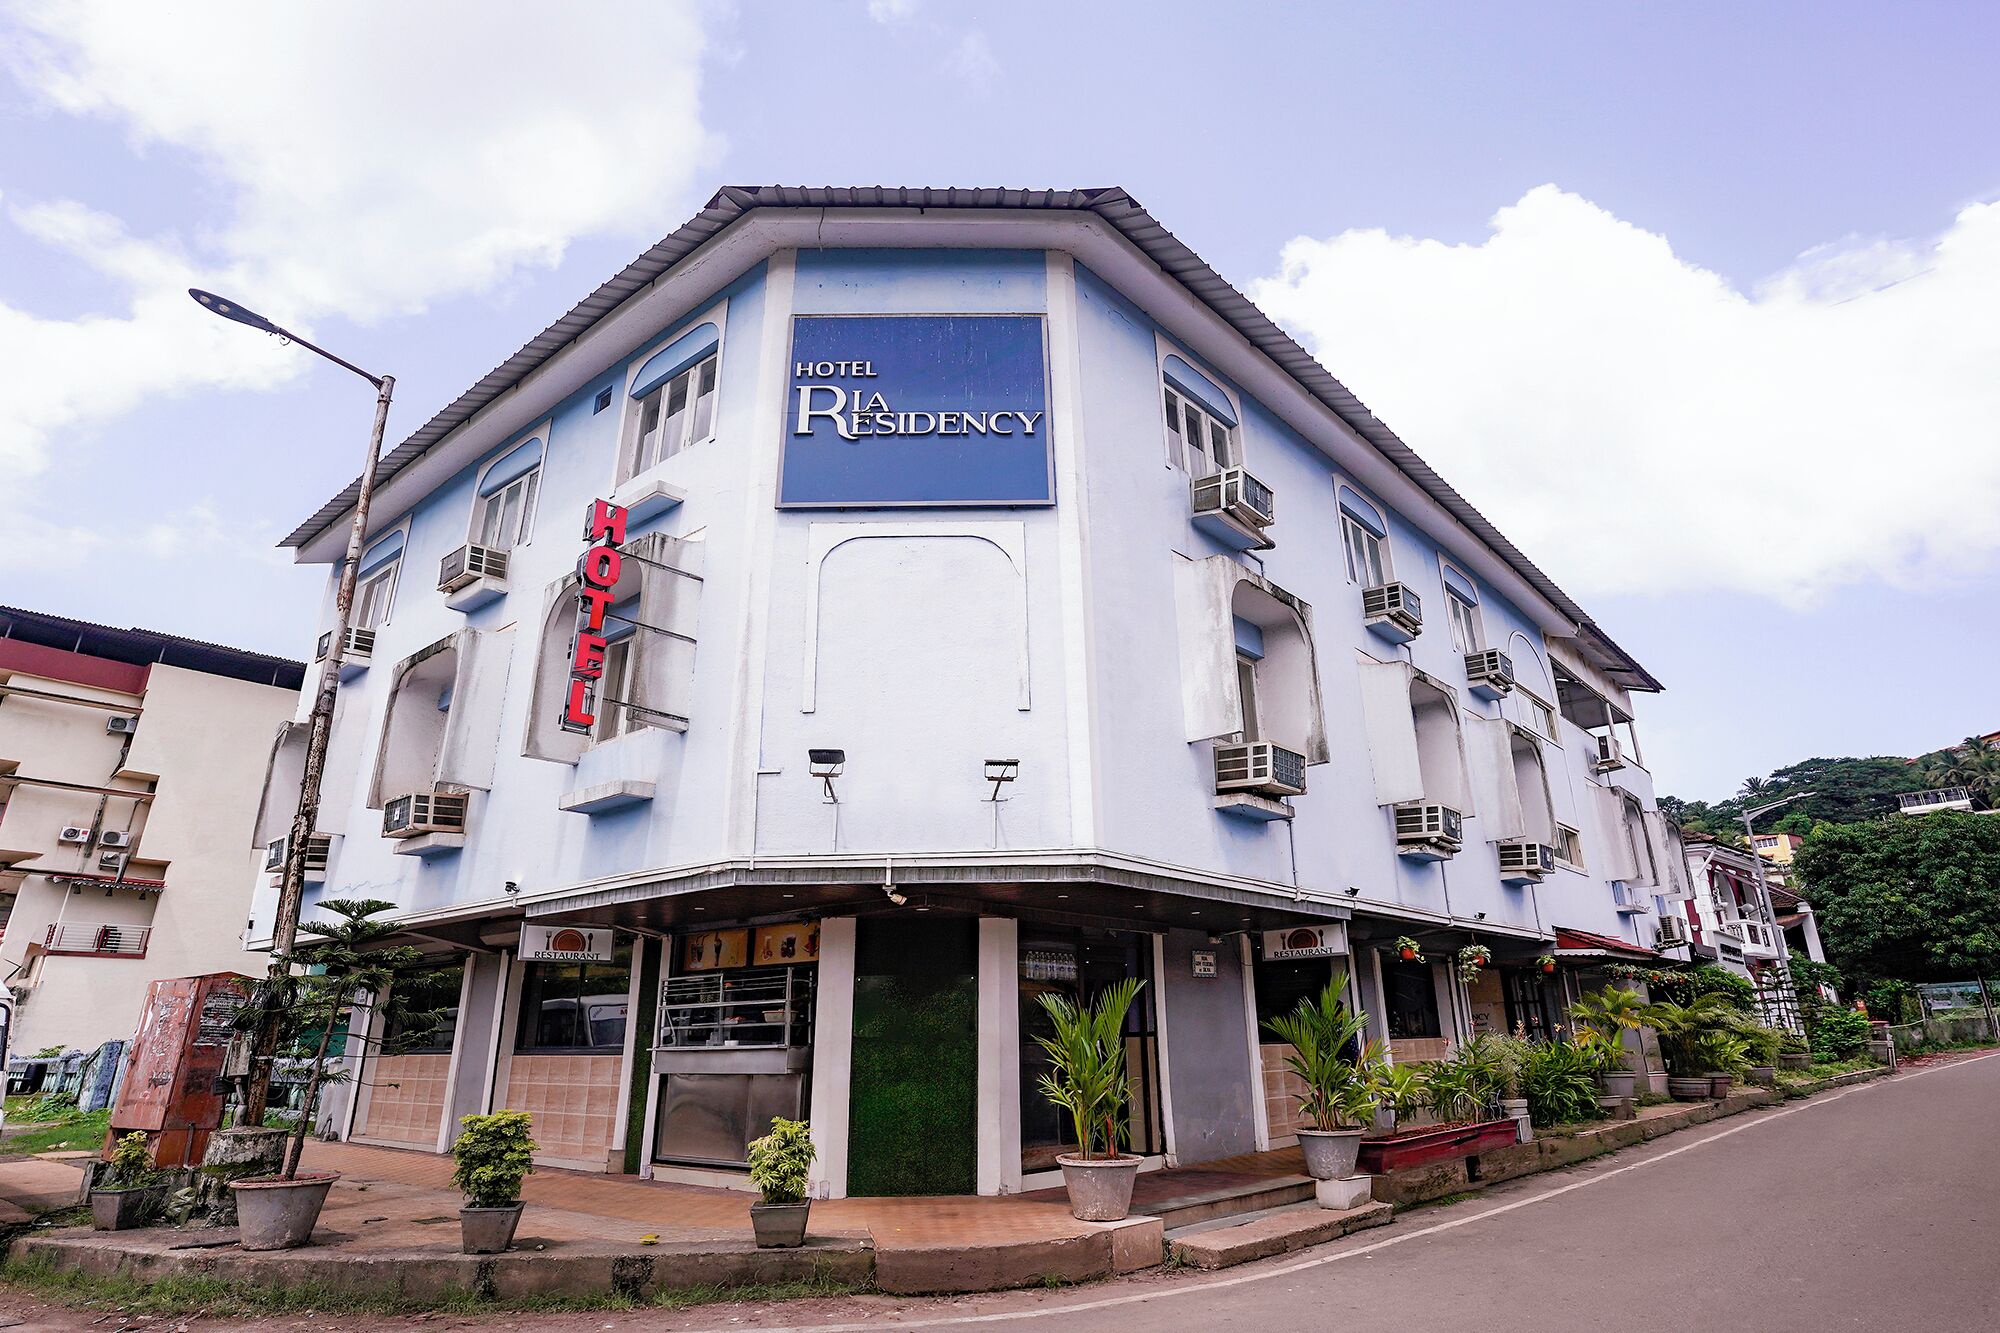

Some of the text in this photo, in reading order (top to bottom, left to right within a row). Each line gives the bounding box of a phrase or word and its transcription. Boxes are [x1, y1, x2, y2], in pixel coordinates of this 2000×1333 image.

[796, 361, 877, 377] HOTEL
[568, 498, 629, 726] HOTEL
[534, 950, 600, 961] RESTAURANT
[1273, 946, 1333, 959] RESTAURANT
